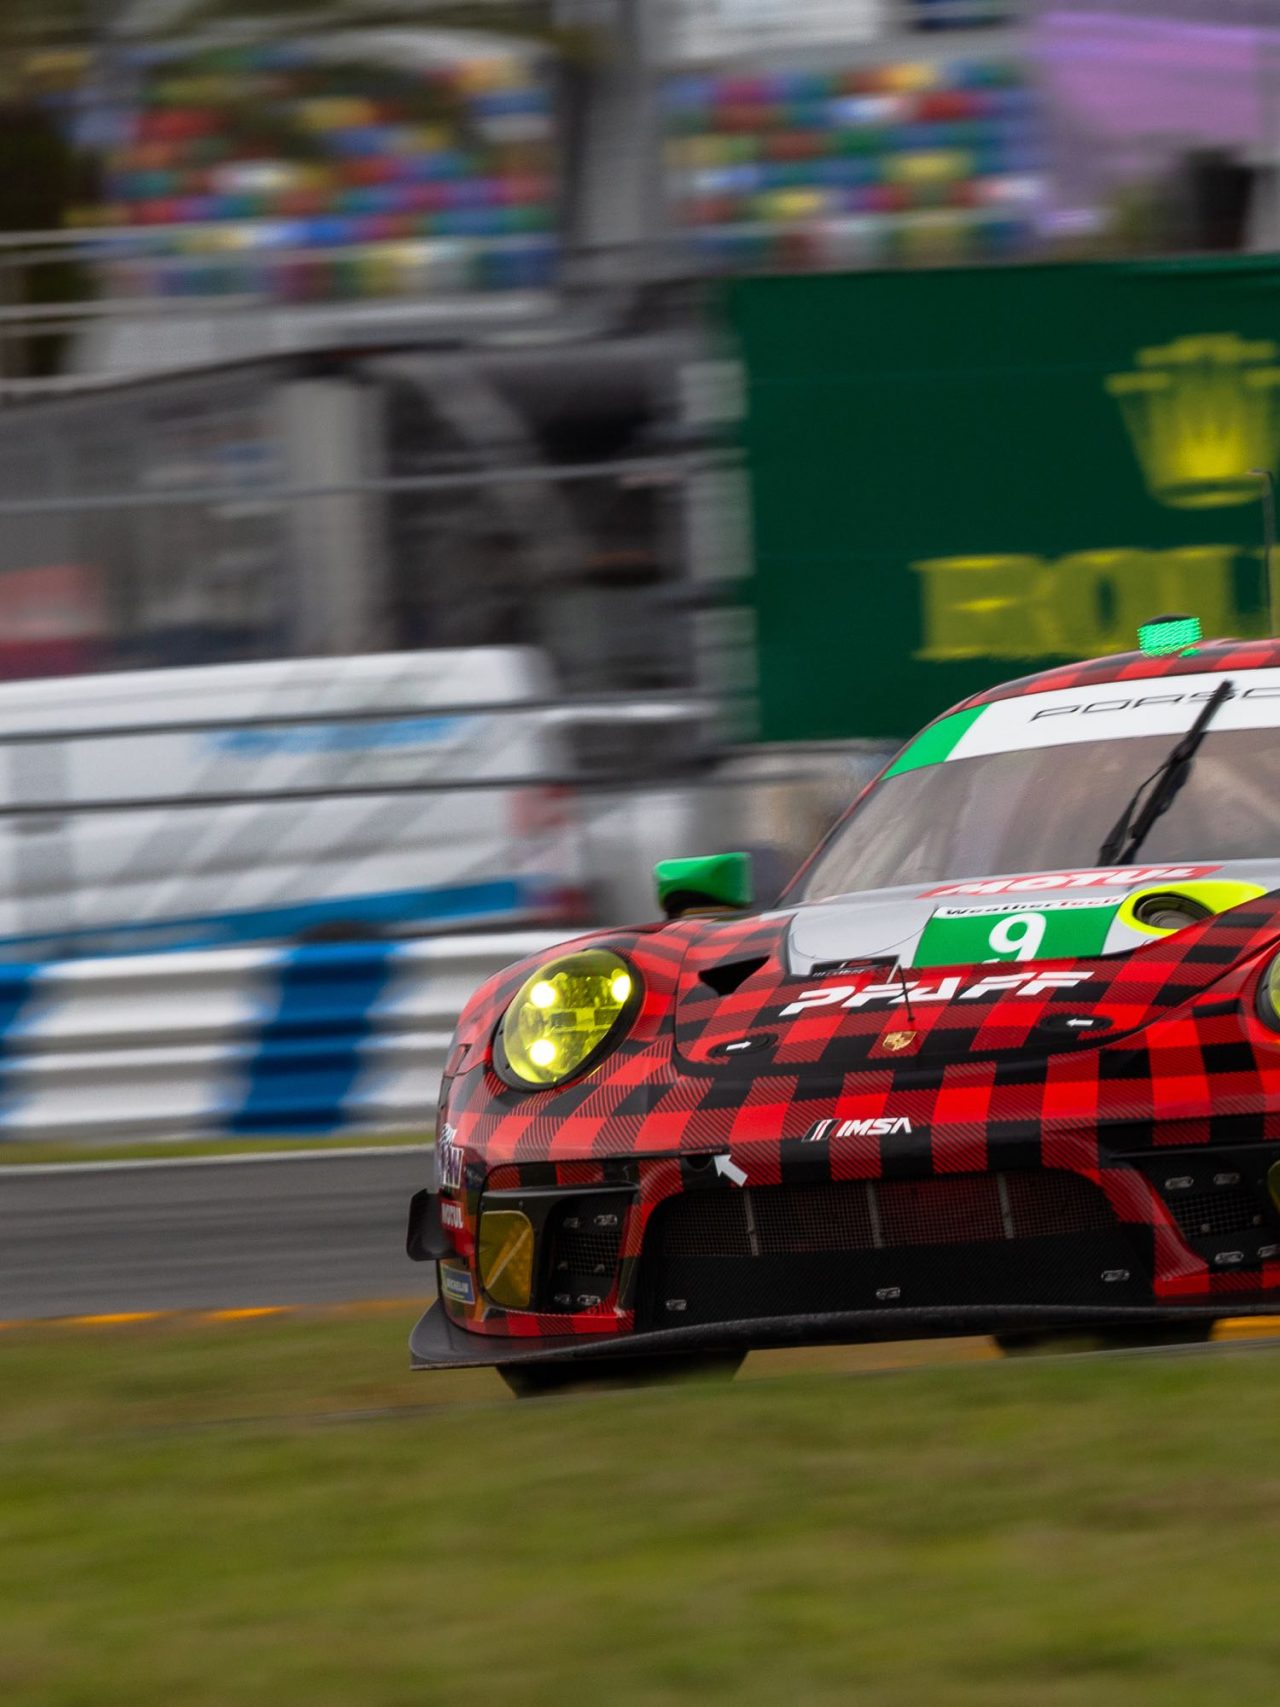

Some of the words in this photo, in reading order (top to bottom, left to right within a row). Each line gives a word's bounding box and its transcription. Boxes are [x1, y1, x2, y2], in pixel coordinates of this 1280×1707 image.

[931, 868, 1206, 898] MOTUL
[946, 896, 1120, 916] WeatherTech
[988, 912, 1047, 961] 9
[835, 1117, 912, 1137] IMSA
